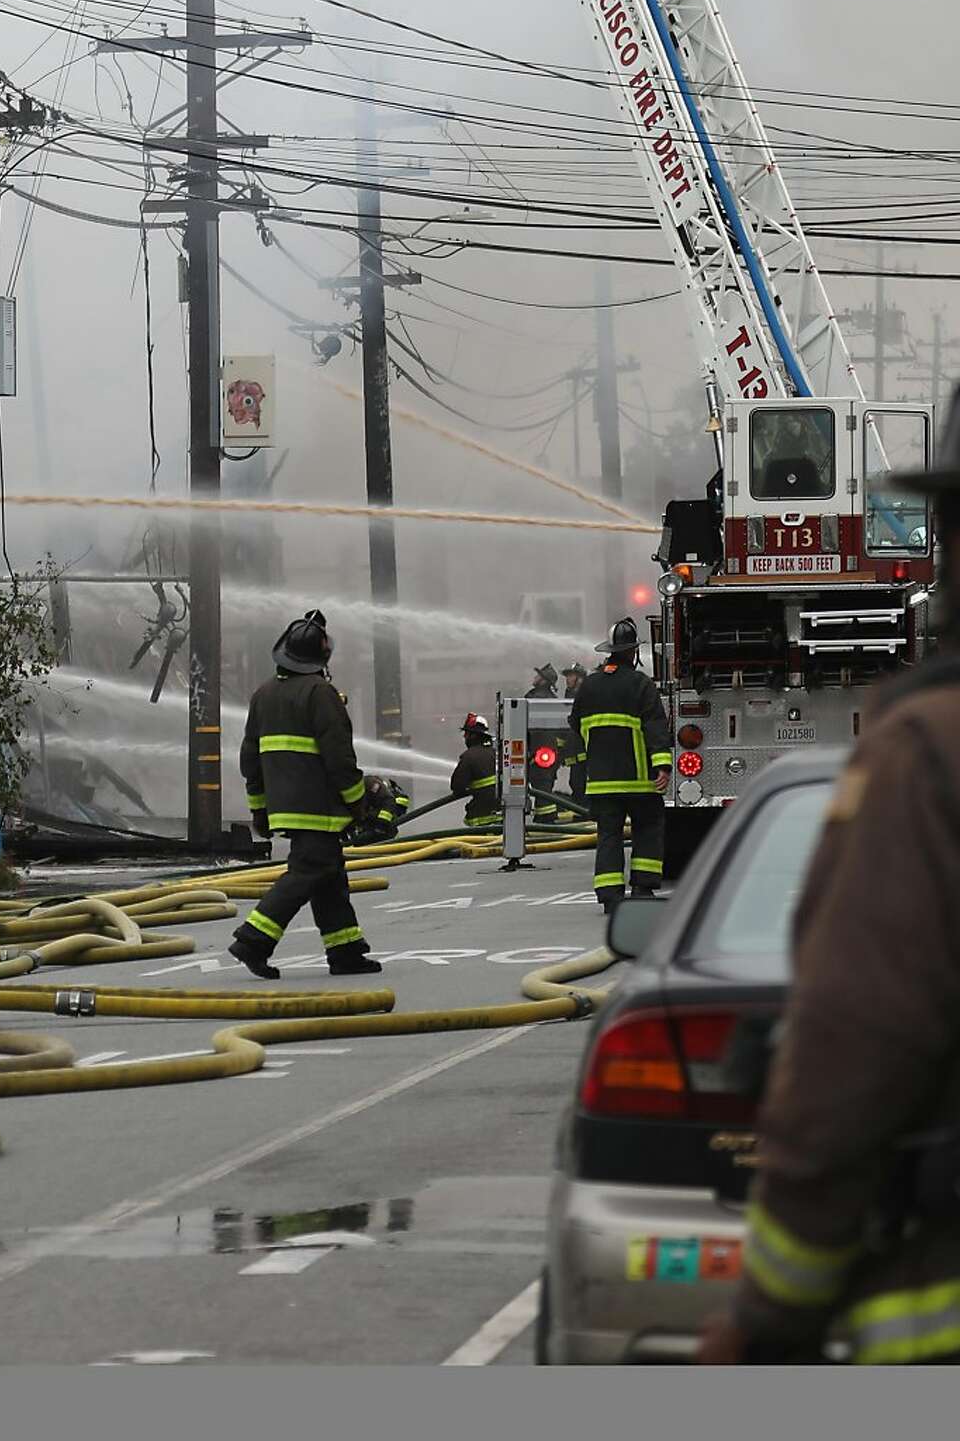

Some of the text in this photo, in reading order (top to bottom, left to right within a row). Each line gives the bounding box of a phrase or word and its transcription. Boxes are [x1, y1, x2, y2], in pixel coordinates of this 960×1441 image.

[629, 68, 663, 132] FIRE
[752, 557, 834, 572] KEEP BACK 500 FEET
